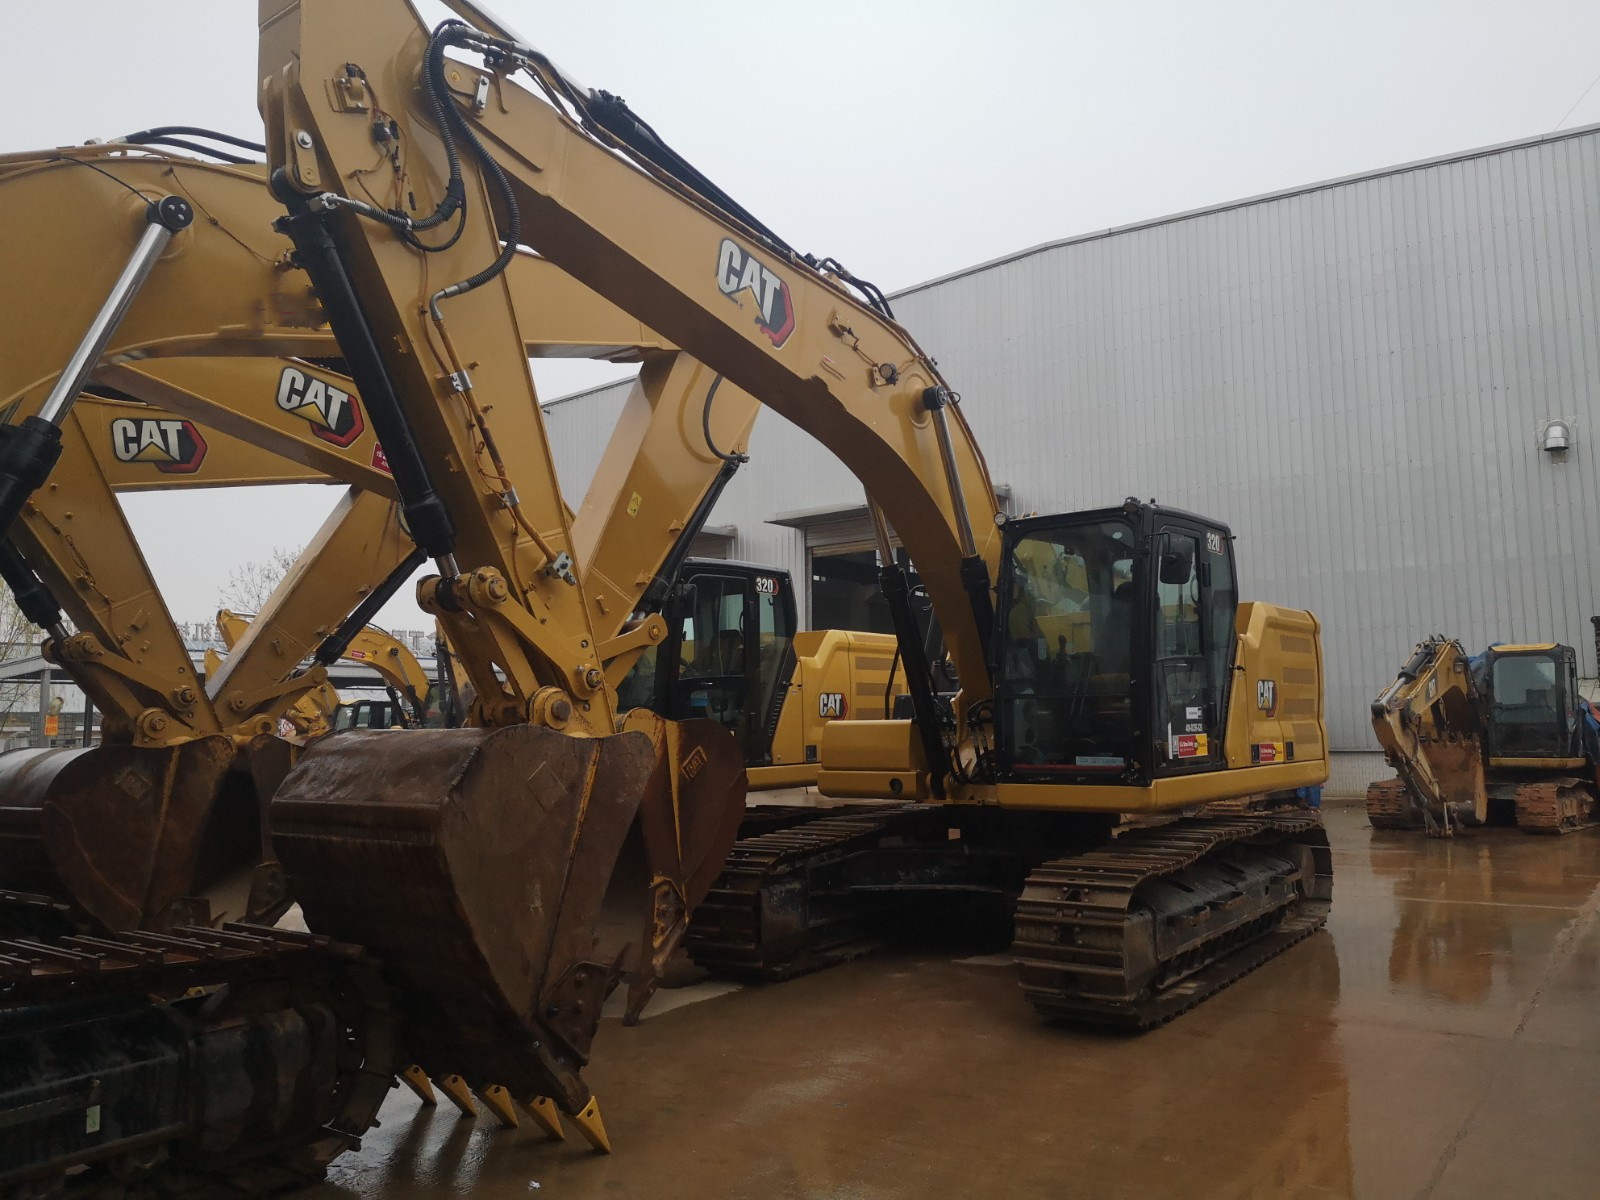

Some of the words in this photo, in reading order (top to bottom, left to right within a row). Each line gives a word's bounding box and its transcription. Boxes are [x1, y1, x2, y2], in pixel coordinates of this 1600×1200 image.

[718, 239, 781, 325] CAT
[277, 366, 349, 431] CAT
[112, 418, 183, 461] CAT
[1207, 532, 1220, 552] 320
[756, 577, 773, 593] 320
[820, 693, 842, 717] CAT
[1257, 680, 1274, 709] CAT
